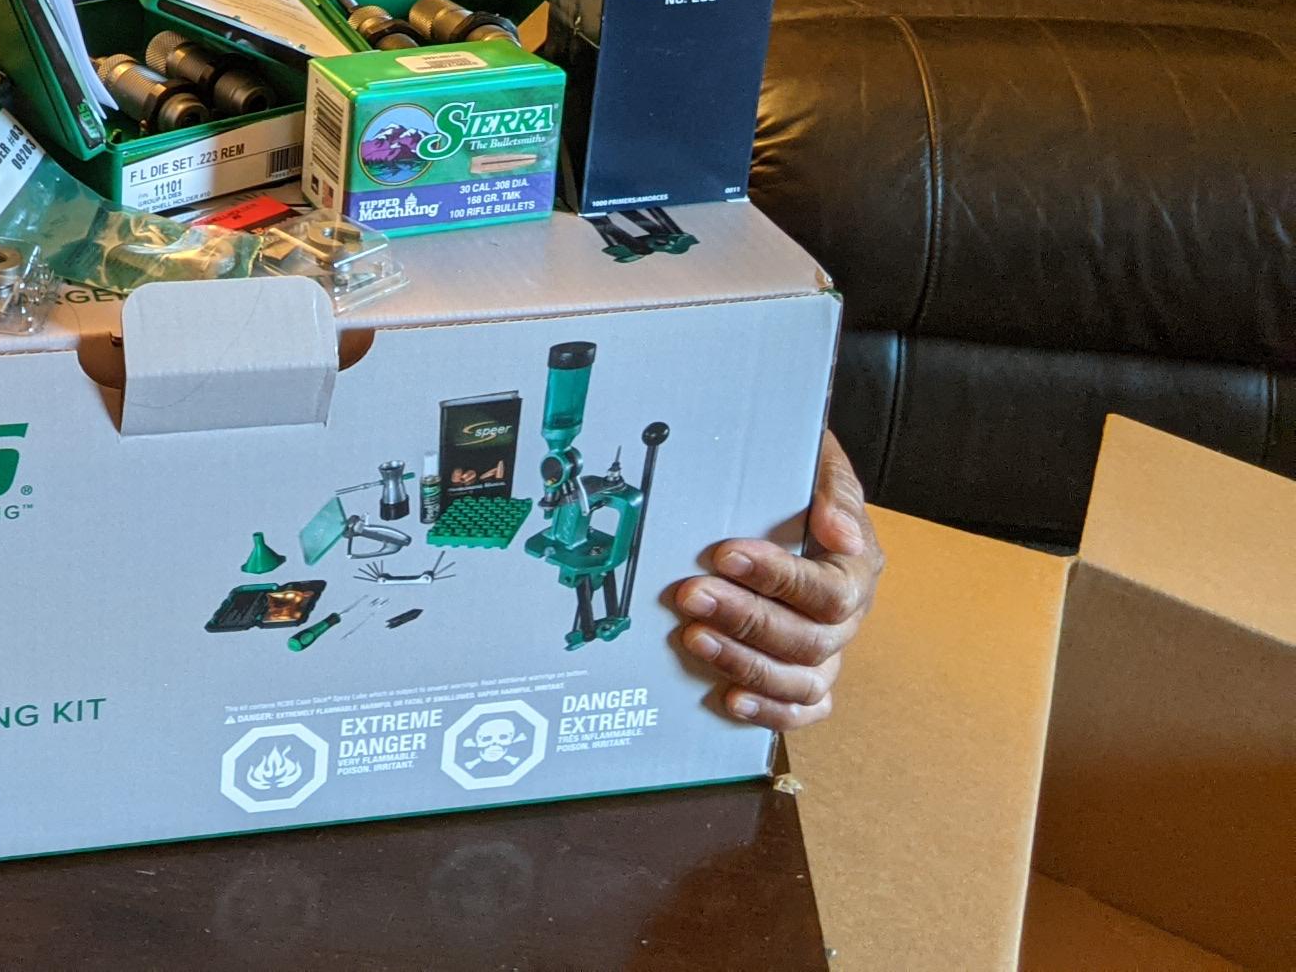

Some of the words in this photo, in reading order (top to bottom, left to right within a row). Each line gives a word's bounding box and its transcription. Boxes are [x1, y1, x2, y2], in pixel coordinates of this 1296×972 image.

[6, 124, 25, 147] #03
[415, 101, 554, 161] SIERRA
[470, 140, 488, 150] The
[490, 134, 545, 148] Bulletsmiths
[11, 138, 37, 171] 09203
[130, 171, 137, 183] F
[140, 168, 147, 180] L
[150, 163, 169, 178] DIE
[172, 156, 194, 172] SET
[196, 150, 218, 166] .223
[220, 143, 245, 160] REM
[154, 178, 182, 197] 11101
[459, 185, 470, 194] 30
[472, 183, 490, 193] CAL
[483, 193, 500, 204] GR.
[502, 191, 521, 201] TMK
[358, 203, 440, 221] MatchKing
[359, 198, 400, 210] TIPPED
[449, 209, 465, 219] 100
[467, 205, 493, 217] RIFLE
[494, 201, 535, 214] BULLETS
[474, 425, 513, 439] speer
[53, 697, 107, 724] KIT
[561, 687, 648, 714] DANGER
[340, 708, 443, 737] EXTREME
[559, 707, 659, 736] EXTRÊME
[338, 732, 427, 758] DANGER
[337, 757, 360, 767] VERY
